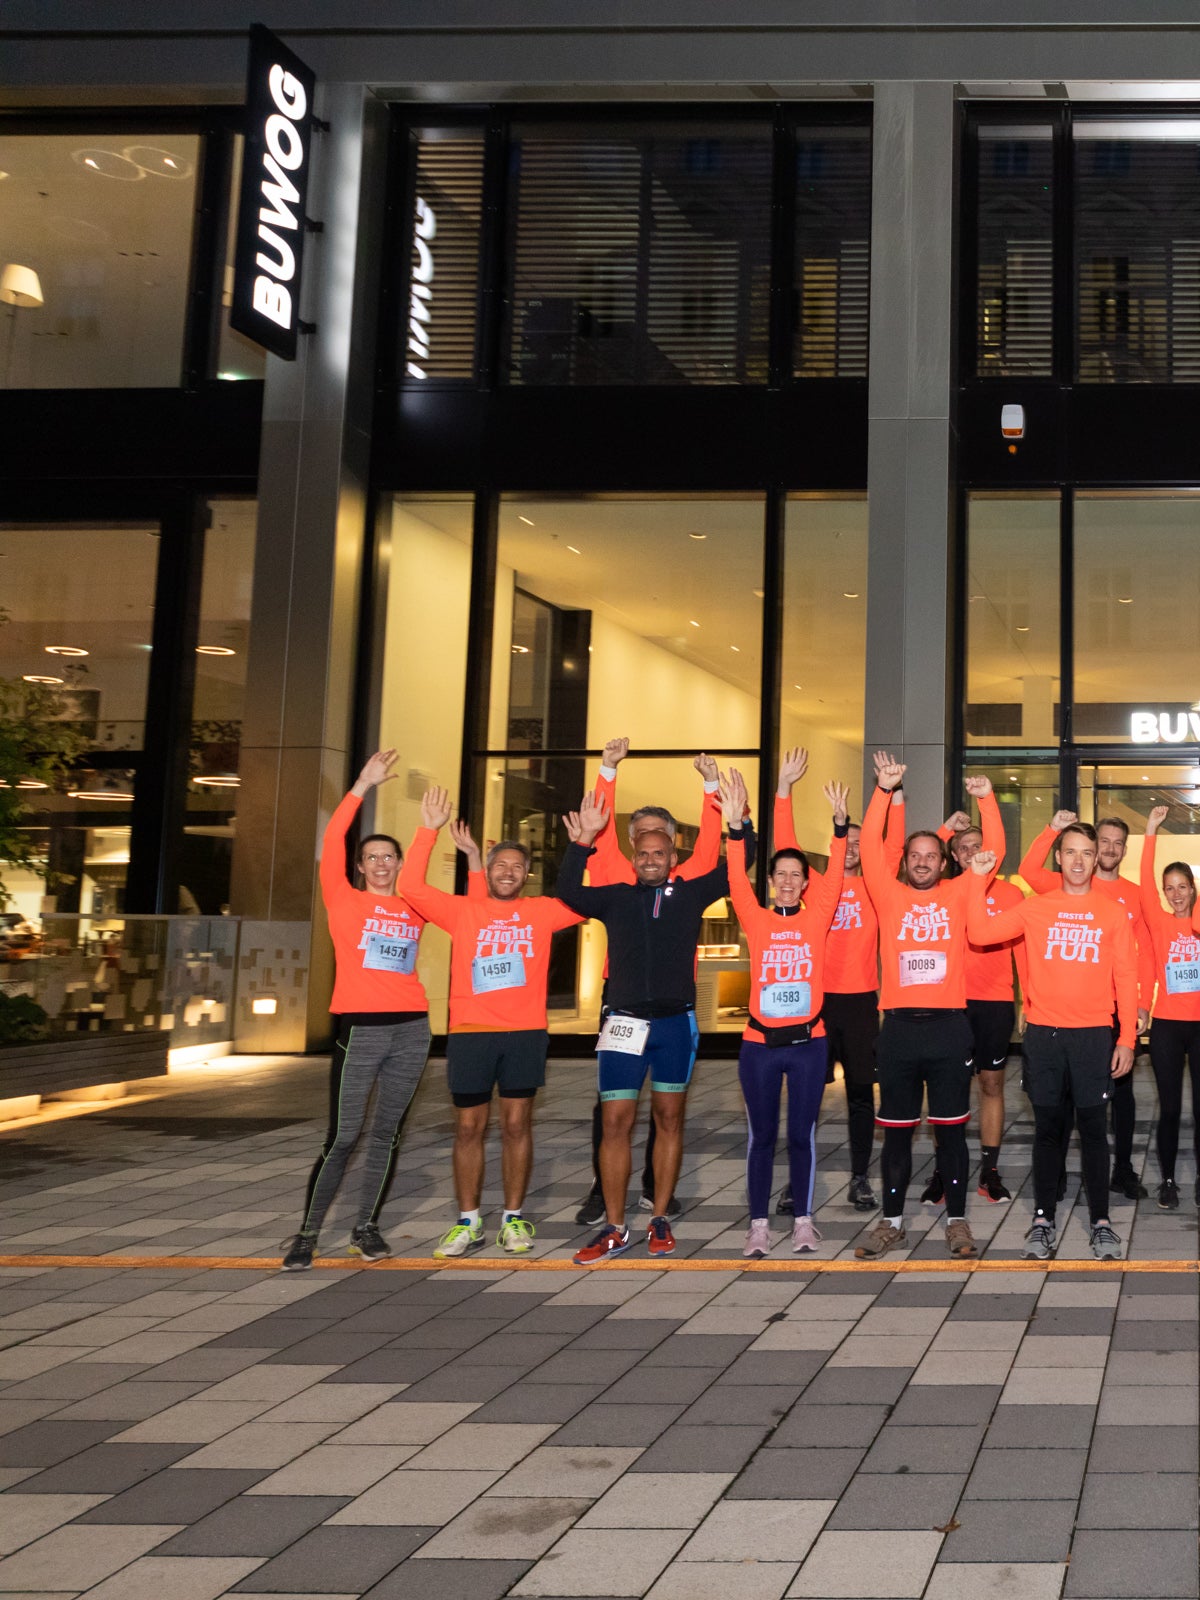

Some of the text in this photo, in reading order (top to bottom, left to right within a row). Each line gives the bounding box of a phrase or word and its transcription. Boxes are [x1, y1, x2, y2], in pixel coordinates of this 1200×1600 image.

[252, 63, 307, 330] BUWOG
[1058, 912, 1084, 920] ERSTE
[771, 931, 794, 940] ERSTE
[897, 921, 951, 942] run
[1048, 924, 1103, 946] night
[380, 944, 408, 959] 14579
[762, 943, 813, 966] night
[1044, 940, 1099, 963] run
[481, 962, 511, 976] 14587
[759, 959, 813, 982] run
[907, 959, 935, 971] 10089
[1174, 969, 1199, 980] 14580
[772, 991, 800, 1003] 14583
[609, 1024, 633, 1038] 4039
